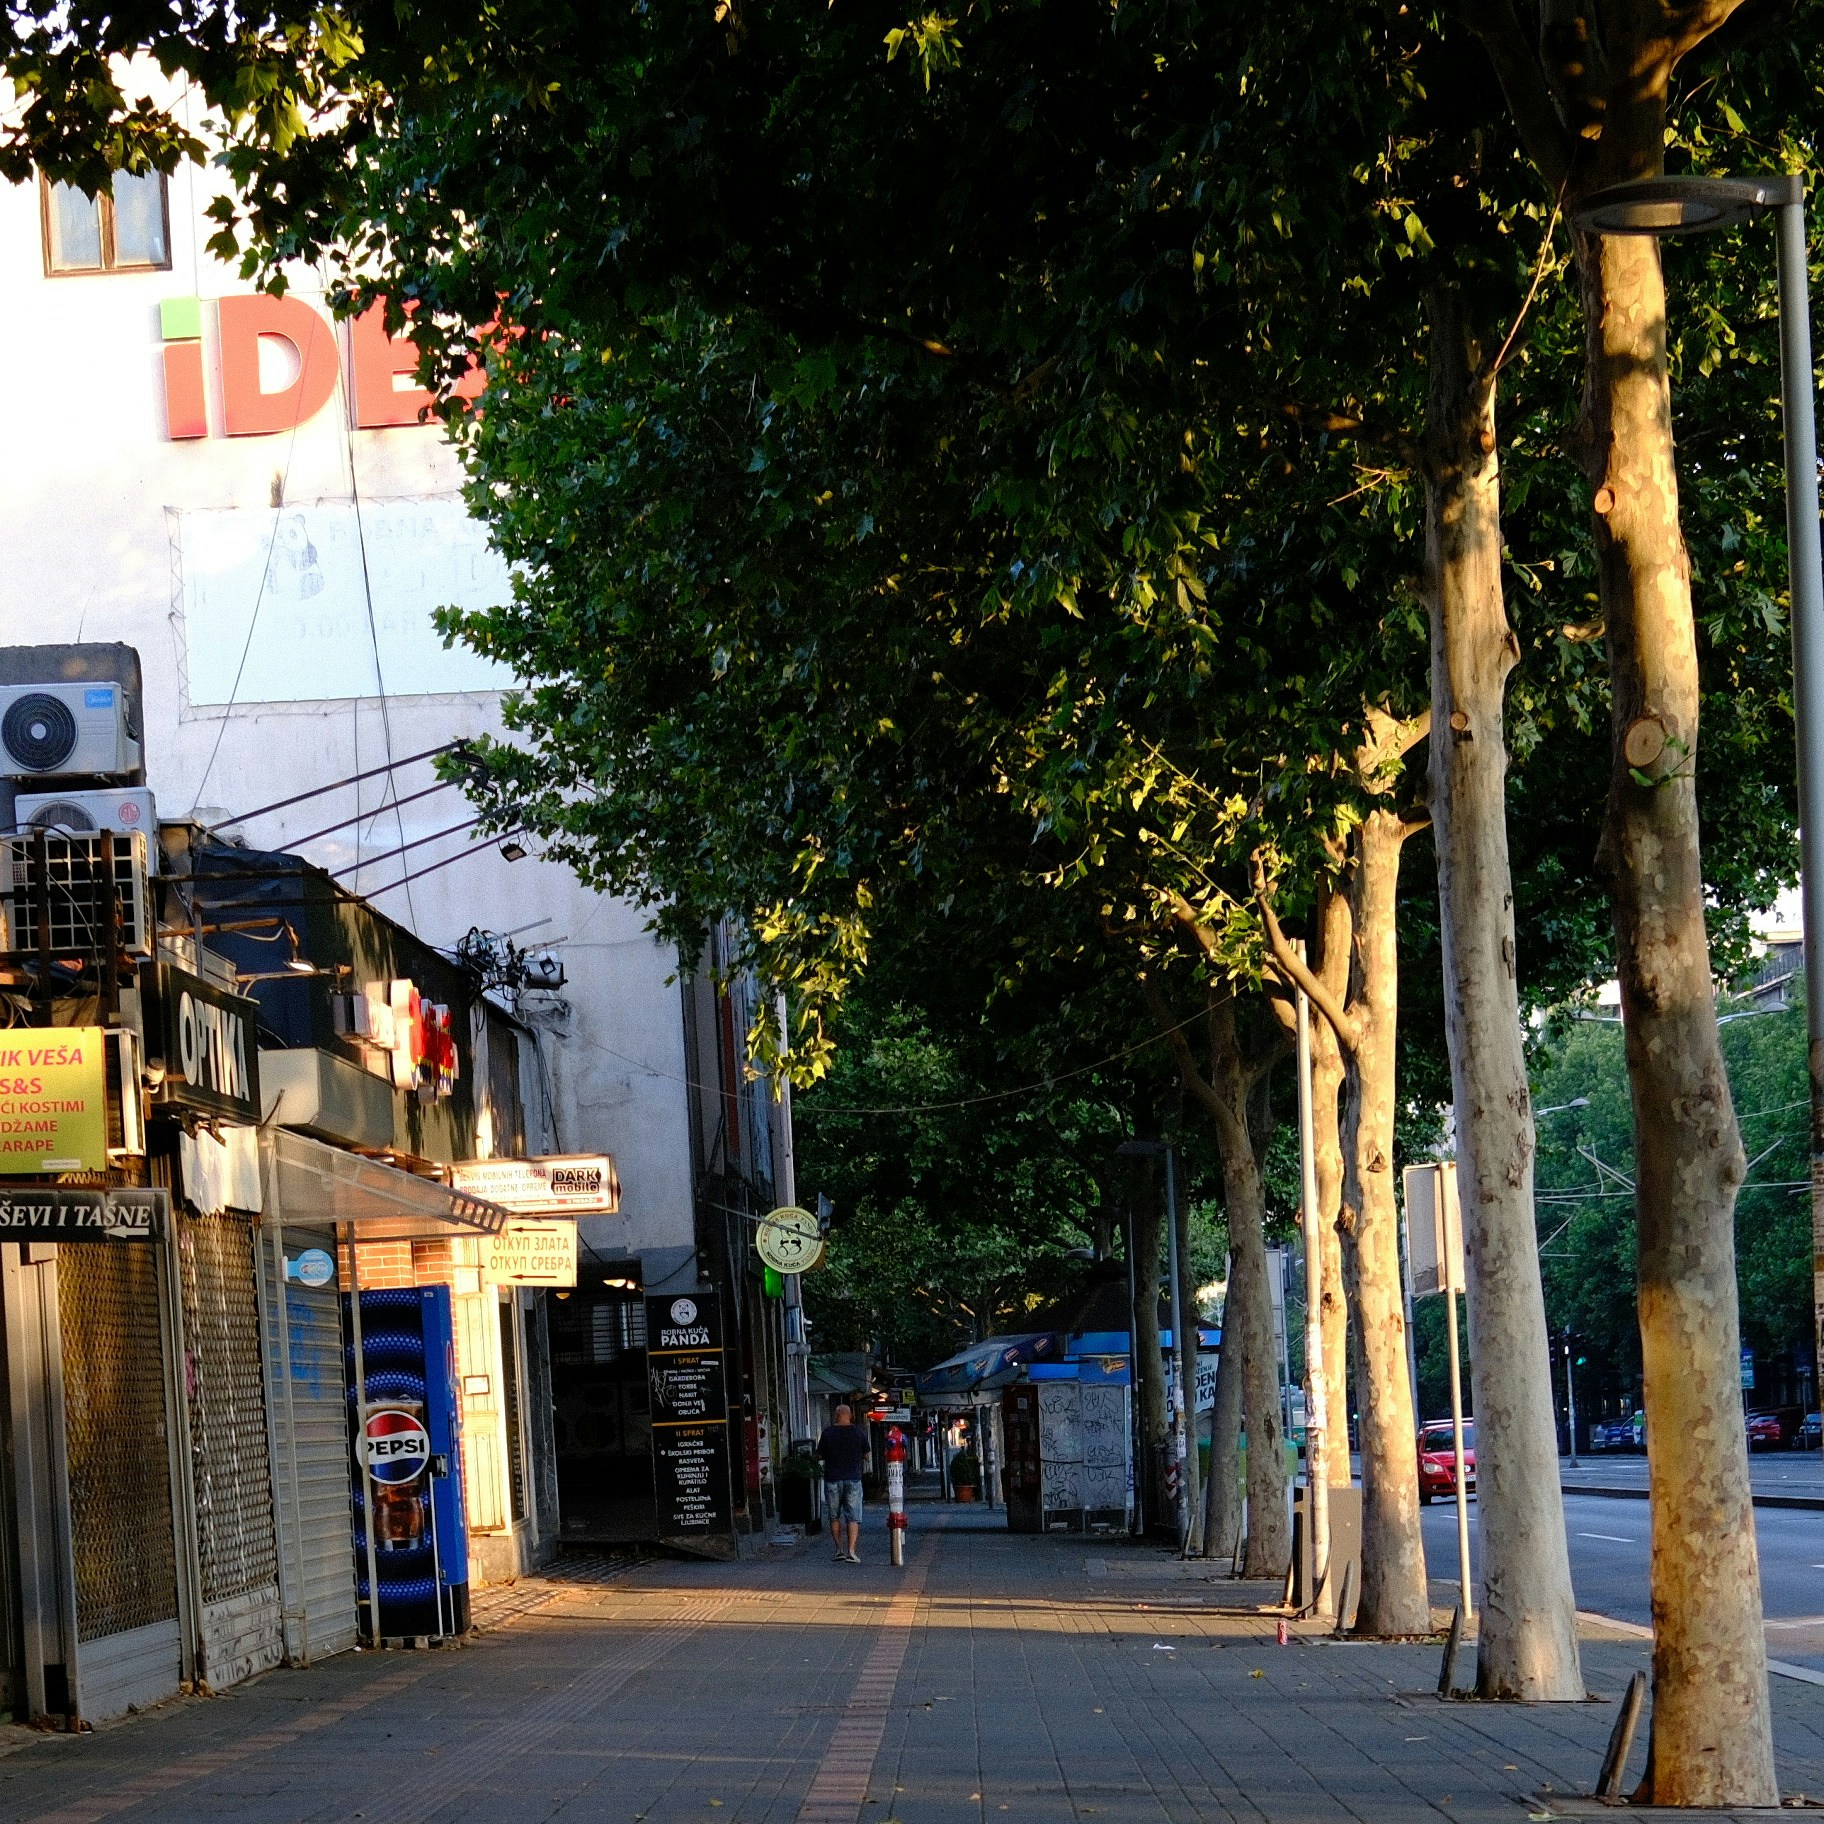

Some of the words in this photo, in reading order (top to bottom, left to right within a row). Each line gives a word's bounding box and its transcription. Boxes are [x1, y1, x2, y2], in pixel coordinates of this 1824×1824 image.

[160, 293, 521, 438] iDE
[179, 991, 250, 1102] OPTIKA
[28, 1045, 83, 1066] VEŠA
[0, 1077, 43, 1095] S&S
[19, 1100, 85, 1114] KOSTIMI
[514, 1167, 547, 1180] TELEFONA
[554, 1168, 598, 1183] DARK
[555, 1181, 599, 1194] mobile
[57, 1205, 68, 1227] I
[73, 1200, 152, 1227] TAŠNE
[493, 1236, 530, 1251] ОТКУП
[534, 1236, 569, 1251] ЗЛАТА
[490, 1255, 527, 1270] ОТКУП
[531, 1255, 572, 1270] СРЕБРА
[661, 1334, 710, 1347] PANDA
